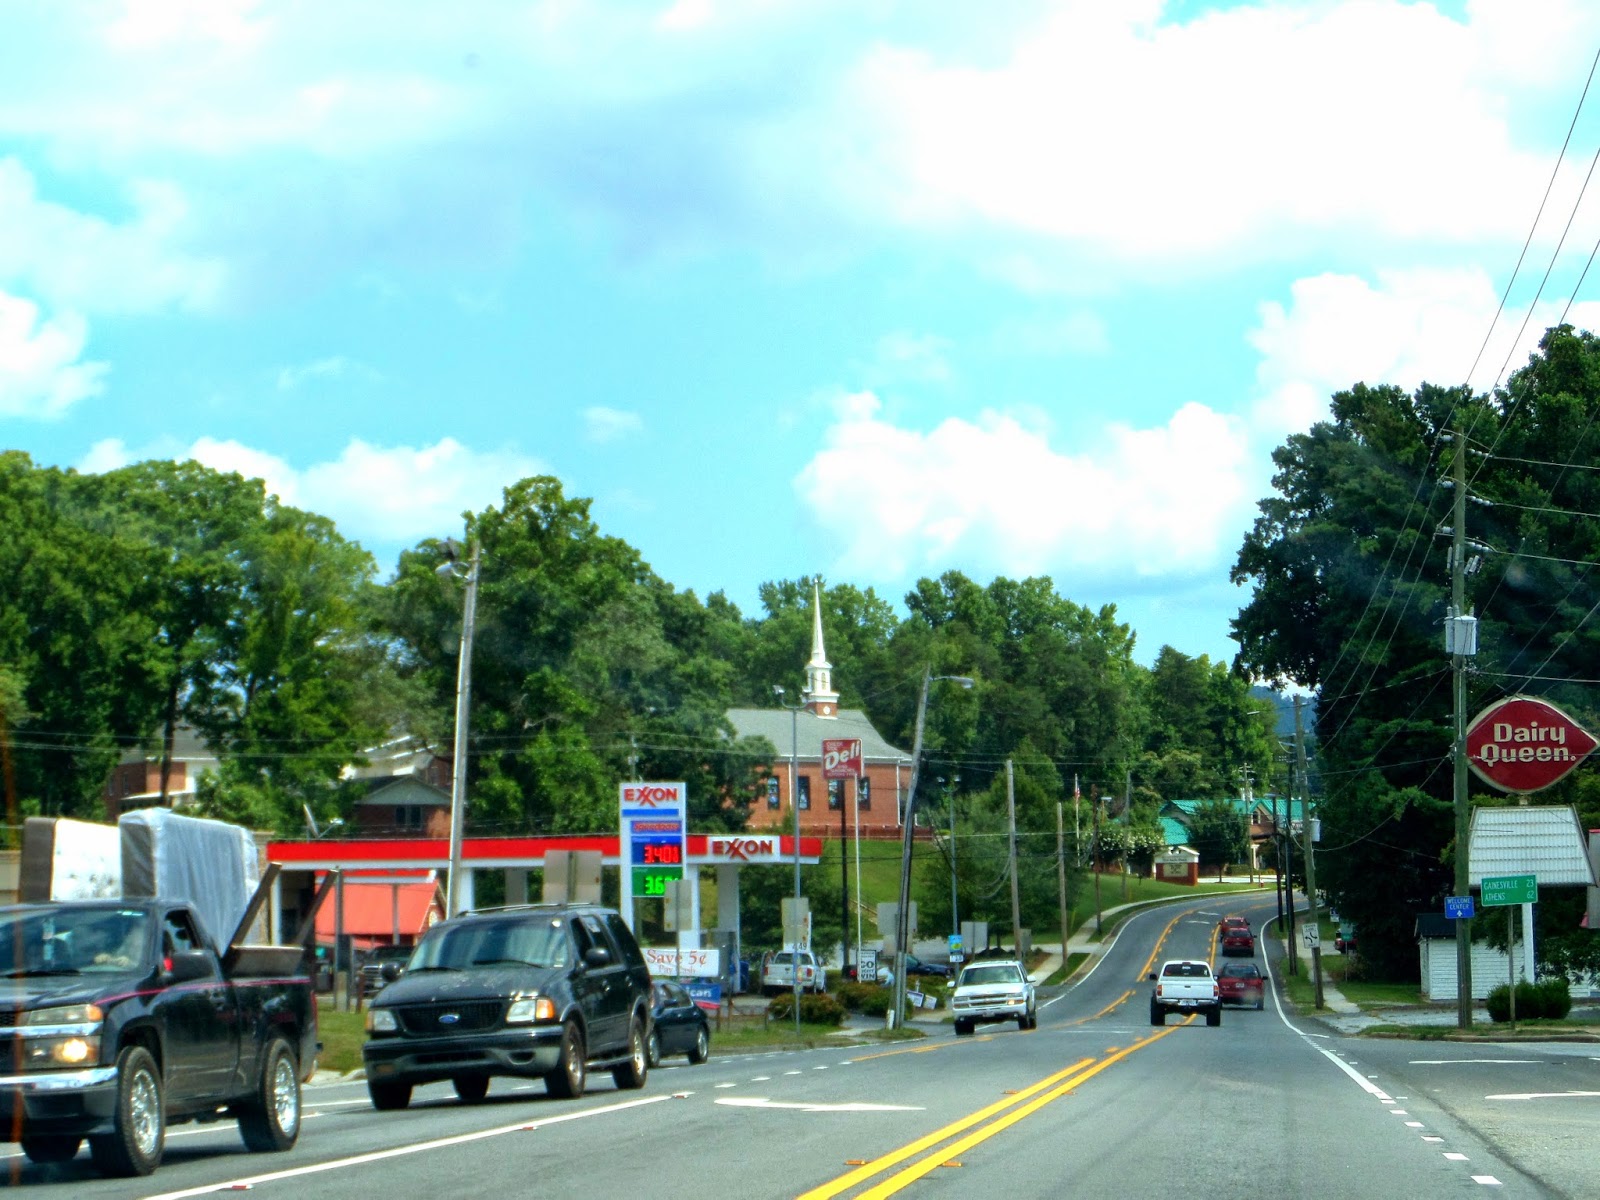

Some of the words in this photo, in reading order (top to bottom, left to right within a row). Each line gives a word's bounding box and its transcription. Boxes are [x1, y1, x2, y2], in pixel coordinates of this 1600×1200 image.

[1493, 721, 1566, 744] Dairy
[824, 740, 860, 770] Deli
[623, 786, 678, 807] EXXON
[712, 838, 773, 860] EXXON
[1483, 880, 1518, 890] GAINESVILLE
[1526, 879, 1534, 888] 23
[1484, 892, 1506, 901] ATHENS
[1526, 891, 1534, 899] 62
[647, 948, 683, 964] Save
[688, 950, 707, 967] 5¢
[658, 965, 673, 974] Pay
[678, 966, 696, 974] ash
